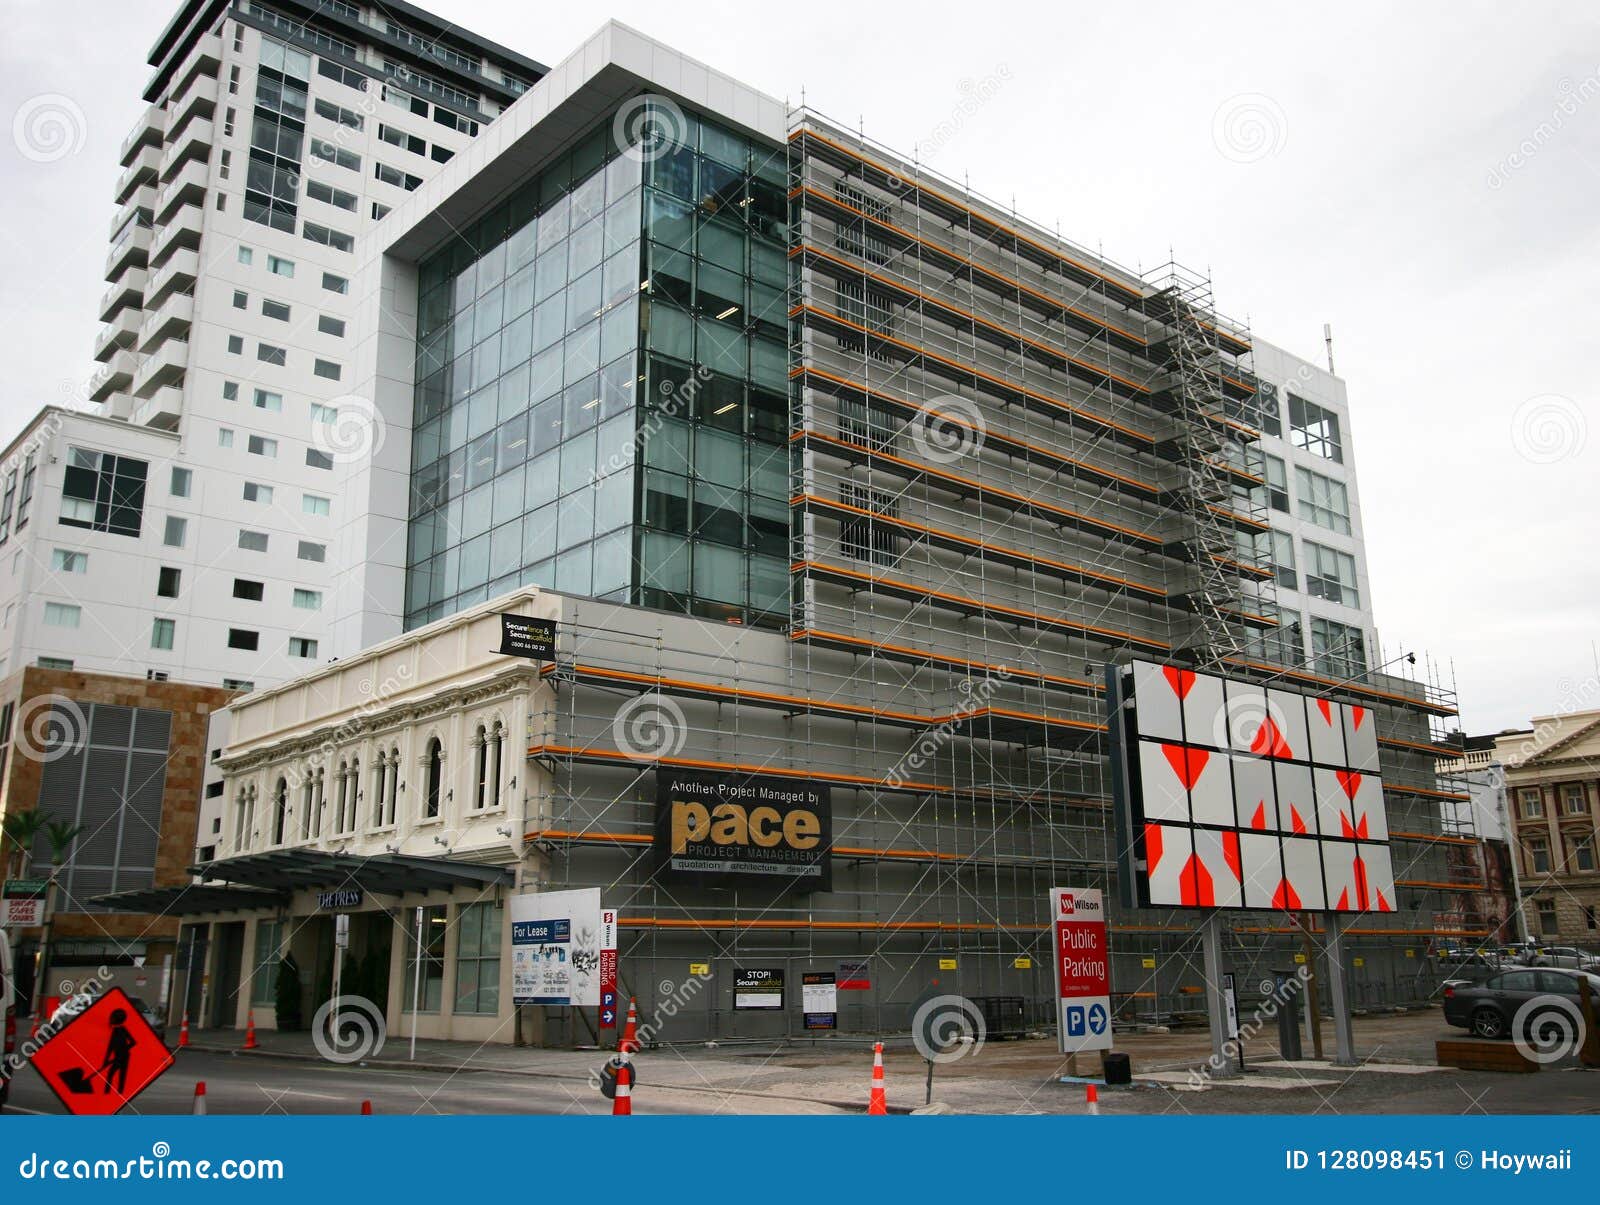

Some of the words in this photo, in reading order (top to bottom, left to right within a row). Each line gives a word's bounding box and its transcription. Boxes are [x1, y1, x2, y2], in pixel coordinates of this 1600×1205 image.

[671, 780, 714, 794] Another
[719, 784, 756, 798] Project
[759, 788, 804, 803] Managed
[808, 792, 819, 805] by
[671, 800, 821, 855] pace
[688, 845, 742, 857] PROJECT
[748, 849, 821, 862] MANAGEMENT
[678, 860, 720, 870] quotation
[730, 863, 778, 872] architecture
[786, 865, 815, 874] design
[334, 891, 359, 906] PRESS
[1074, 899, 1099, 911] Wilson
[513, 925, 526, 938] For
[527, 925, 548, 937] Lease
[1061, 928, 1097, 950] Public
[601, 952, 609, 986] PARKING
[746, 970, 771, 979] STOP!
[1063, 957, 1105, 981] Parking
[1071, 1011, 1081, 1031] P
